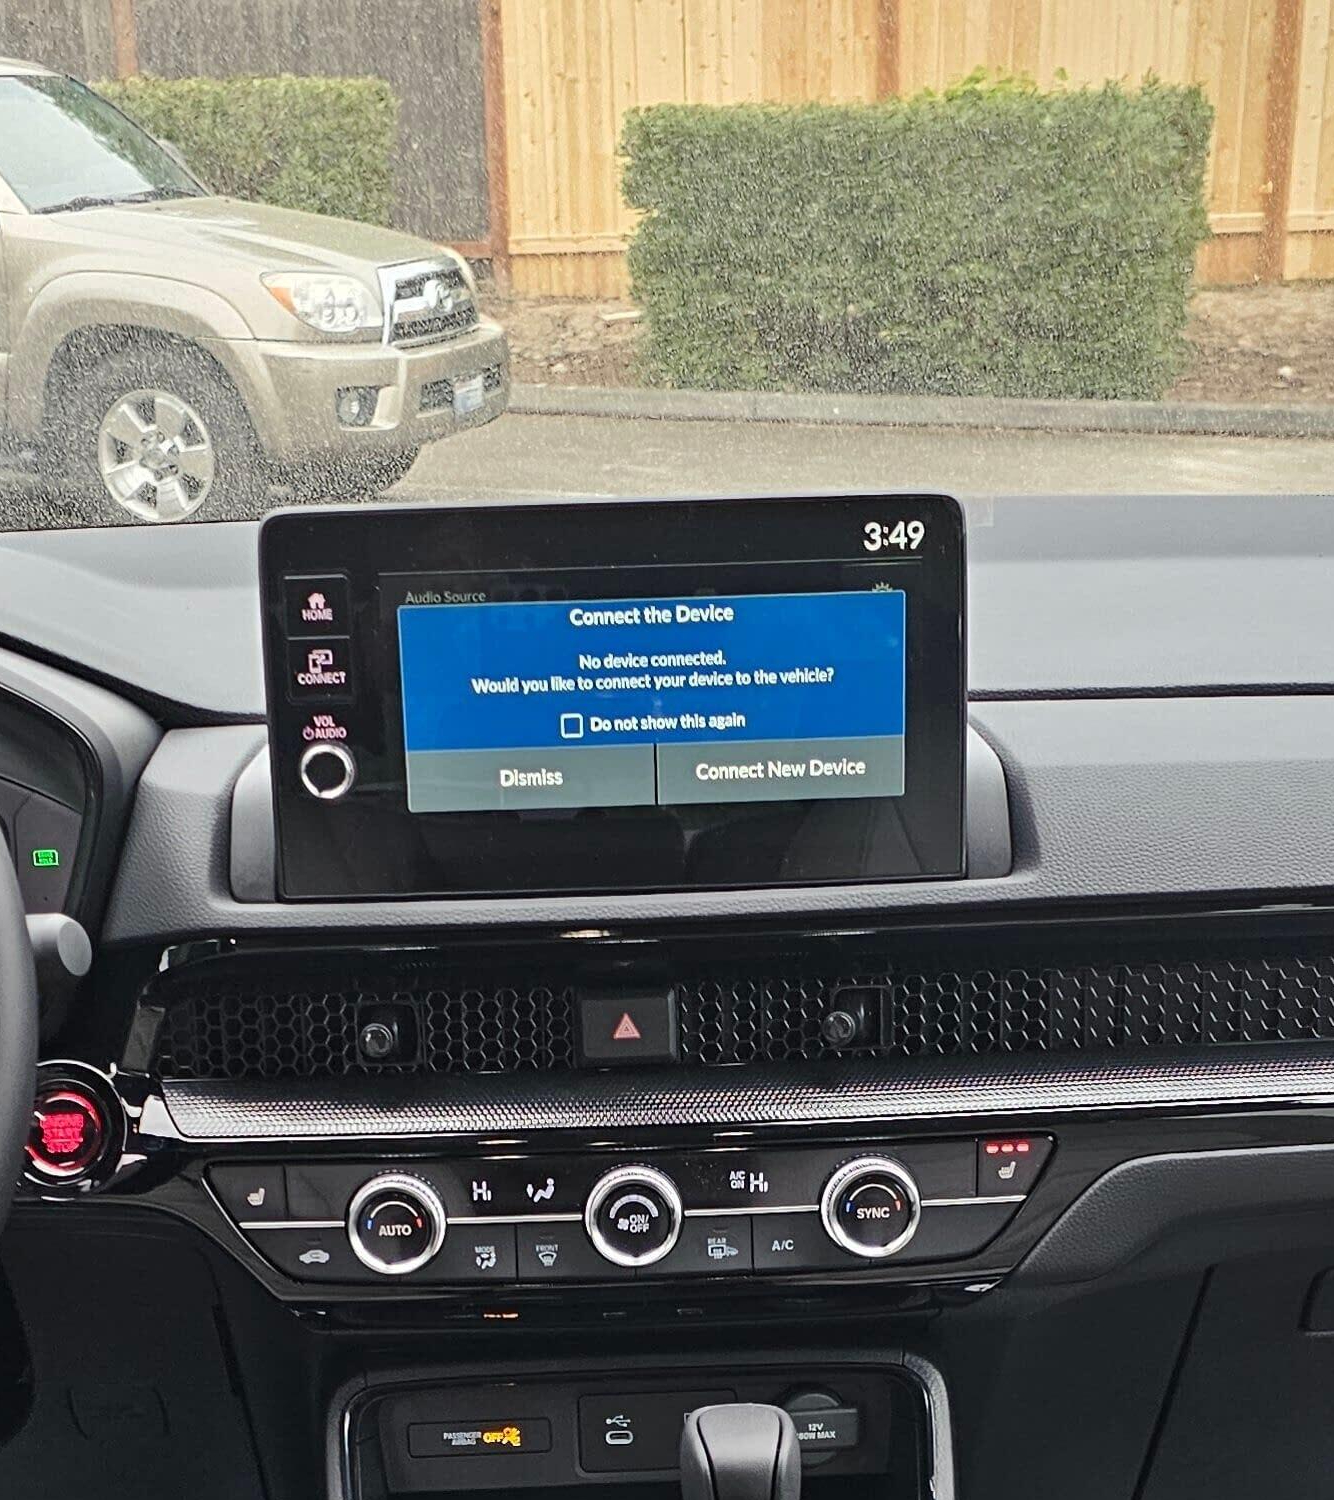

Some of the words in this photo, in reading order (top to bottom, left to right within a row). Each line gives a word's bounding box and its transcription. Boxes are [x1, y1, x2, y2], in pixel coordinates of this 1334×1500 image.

[863, 520, 925, 551] 3:49
[405, 591, 442, 605] Audio
[444, 590, 487, 603] Source
[302, 608, 333, 621] HOME
[569, 607, 641, 626] Connect
[644, 606, 673, 624] the
[675, 604, 735, 623] Device
[579, 654, 601, 670] No
[603, 653, 649, 669] device
[650, 650, 727, 667] connected.
[297, 671, 347, 685] CONNECT
[471, 677, 519, 694] Would
[521, 678, 549, 695] you
[550, 676, 575, 691] like
[577, 676, 593, 691] to
[595, 674, 651, 690] connect
[654, 673, 686, 690] your
[688, 670, 734, 687] device
[736, 671, 752, 685] to
[754, 669, 778, 684] the
[779, 667, 835, 684] vehicle?
[313, 715, 336, 727] VOL
[590, 716, 612, 732] Do
[614, 716, 639, 731] not
[640, 714, 678, 730] show
[680, 713, 706, 729] this
[708, 712, 746, 730] again
[315, 728, 347, 739] AUDIO
[695, 762, 765, 781] Connect
[767, 760, 806, 778] New
[809, 758, 866, 776] Device
[499, 768, 564, 788] Dismiss
[856, 1207, 891, 1220] SYNC
[378, 1224, 412, 1237] AUTO
[629, 1223, 650, 1234] OFF
[474, 1245, 496, 1253] MODE
[535, 1244, 559, 1252] FRONT
[771, 1239, 795, 1251] A/C
[808, 1423, 824, 1431] 12V
[483, 1432, 504, 1443] OFF
[796, 1431, 816, 1440] 80W
[817, 1431, 836, 1439] MAX
